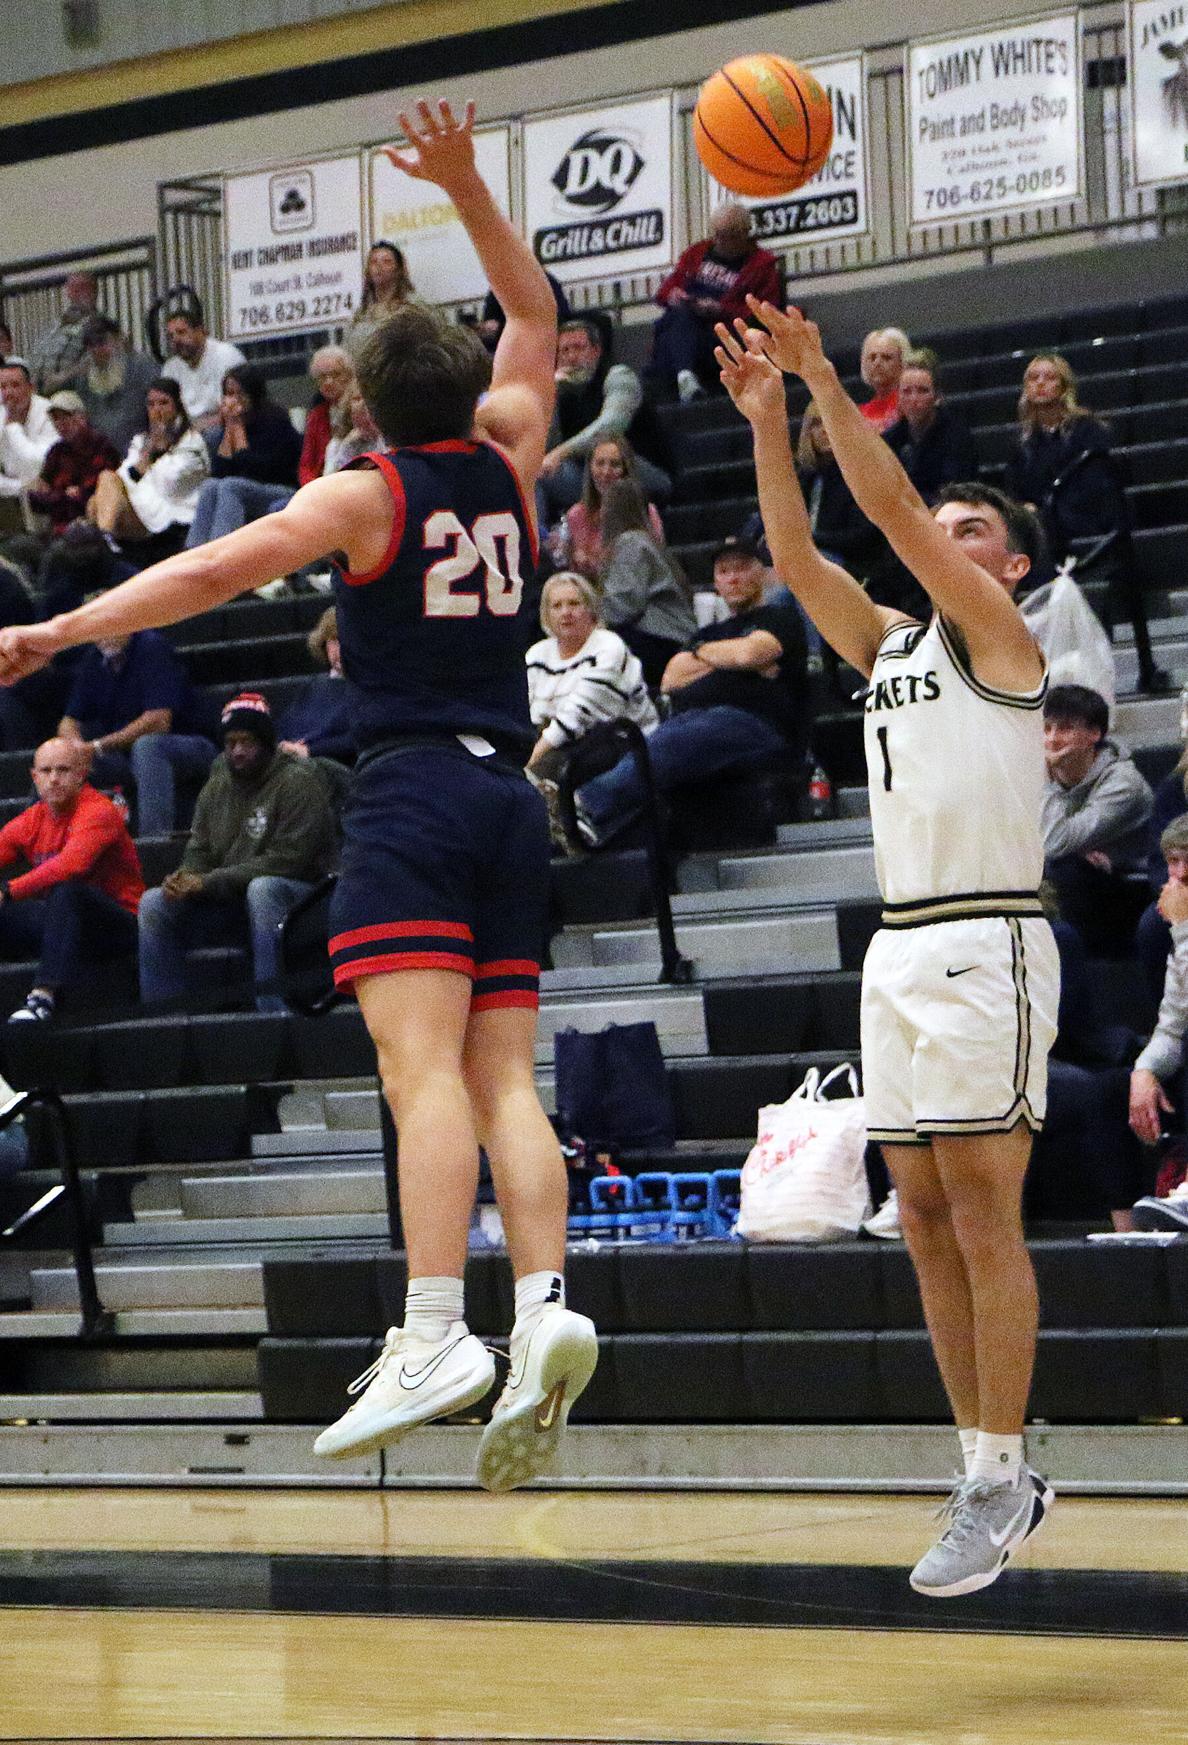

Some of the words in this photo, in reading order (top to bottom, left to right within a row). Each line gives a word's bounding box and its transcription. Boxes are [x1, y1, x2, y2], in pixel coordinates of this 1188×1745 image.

[918, 46, 983, 104] TOMMY
[918, 115, 956, 144] Paint
[959, 107, 985, 138] and
[990, 102, 1026, 132] Body
[1031, 95, 1067, 124] Shop
[563, 140, 637, 197] DQ
[924, 164, 1067, 210] 706-625-0085
[306, 231, 358, 257] INSURANCE
[239, 291, 352, 327] 706.629.2274
[422, 508, 524, 619] 20
[876, 725, 893, 793] 1
